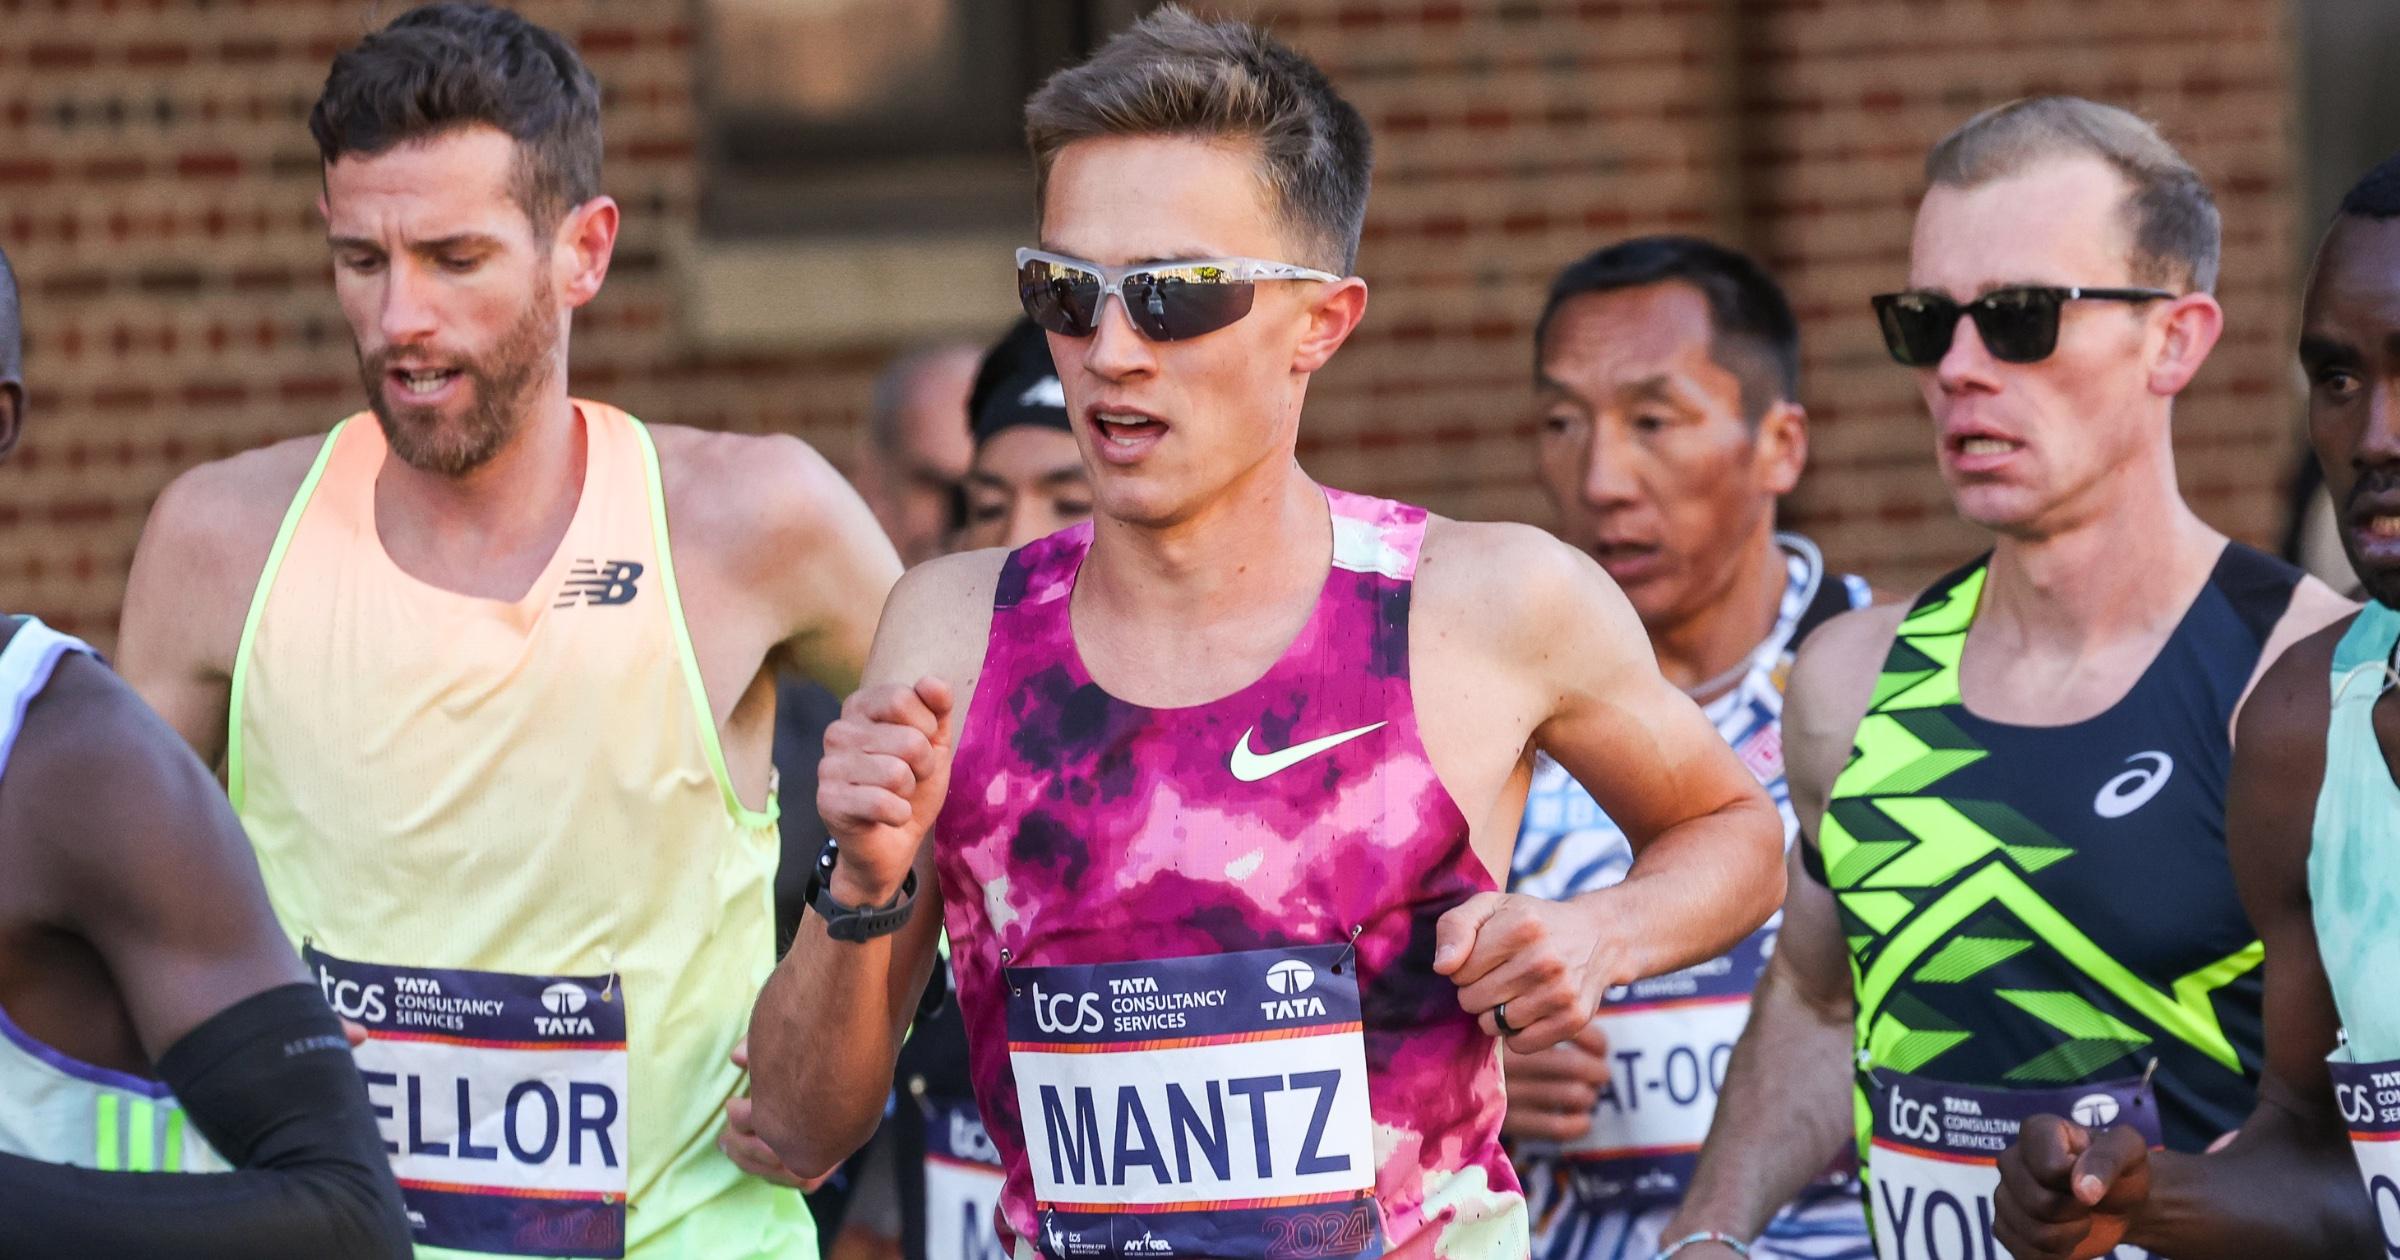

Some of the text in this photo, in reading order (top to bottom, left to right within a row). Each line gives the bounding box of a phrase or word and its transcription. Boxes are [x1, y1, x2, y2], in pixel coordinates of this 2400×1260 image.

[320, 964, 386, 1022] tcs
[394, 977, 440, 995] TATA
[1109, 977, 1159, 994] TATA
[394, 994, 503, 1016] CONSULTANCY
[1032, 982, 1104, 1035] tcs
[1111, 989, 1227, 1014] CONSULTANCY
[1261, 997, 1327, 1021] TATA
[396, 1010, 463, 1031] SERVICES
[534, 1016, 594, 1036] TATA
[1114, 1012, 1187, 1033] SERVICES
[2370, 1071, 2400, 1088] TAT
[1890, 1085, 1941, 1143] tcs
[1943, 1096, 1983, 1116] TATA
[2336, 1083, 2375, 1123] cs
[362, 1070, 619, 1168] ELLOR
[1039, 1069, 1351, 1186] MANTZ
[1943, 1114, 2021, 1135] CONSULTAN
[1946, 1131, 2006, 1151] SERVICES
[1261, 1206, 1374, 1260] 2024
